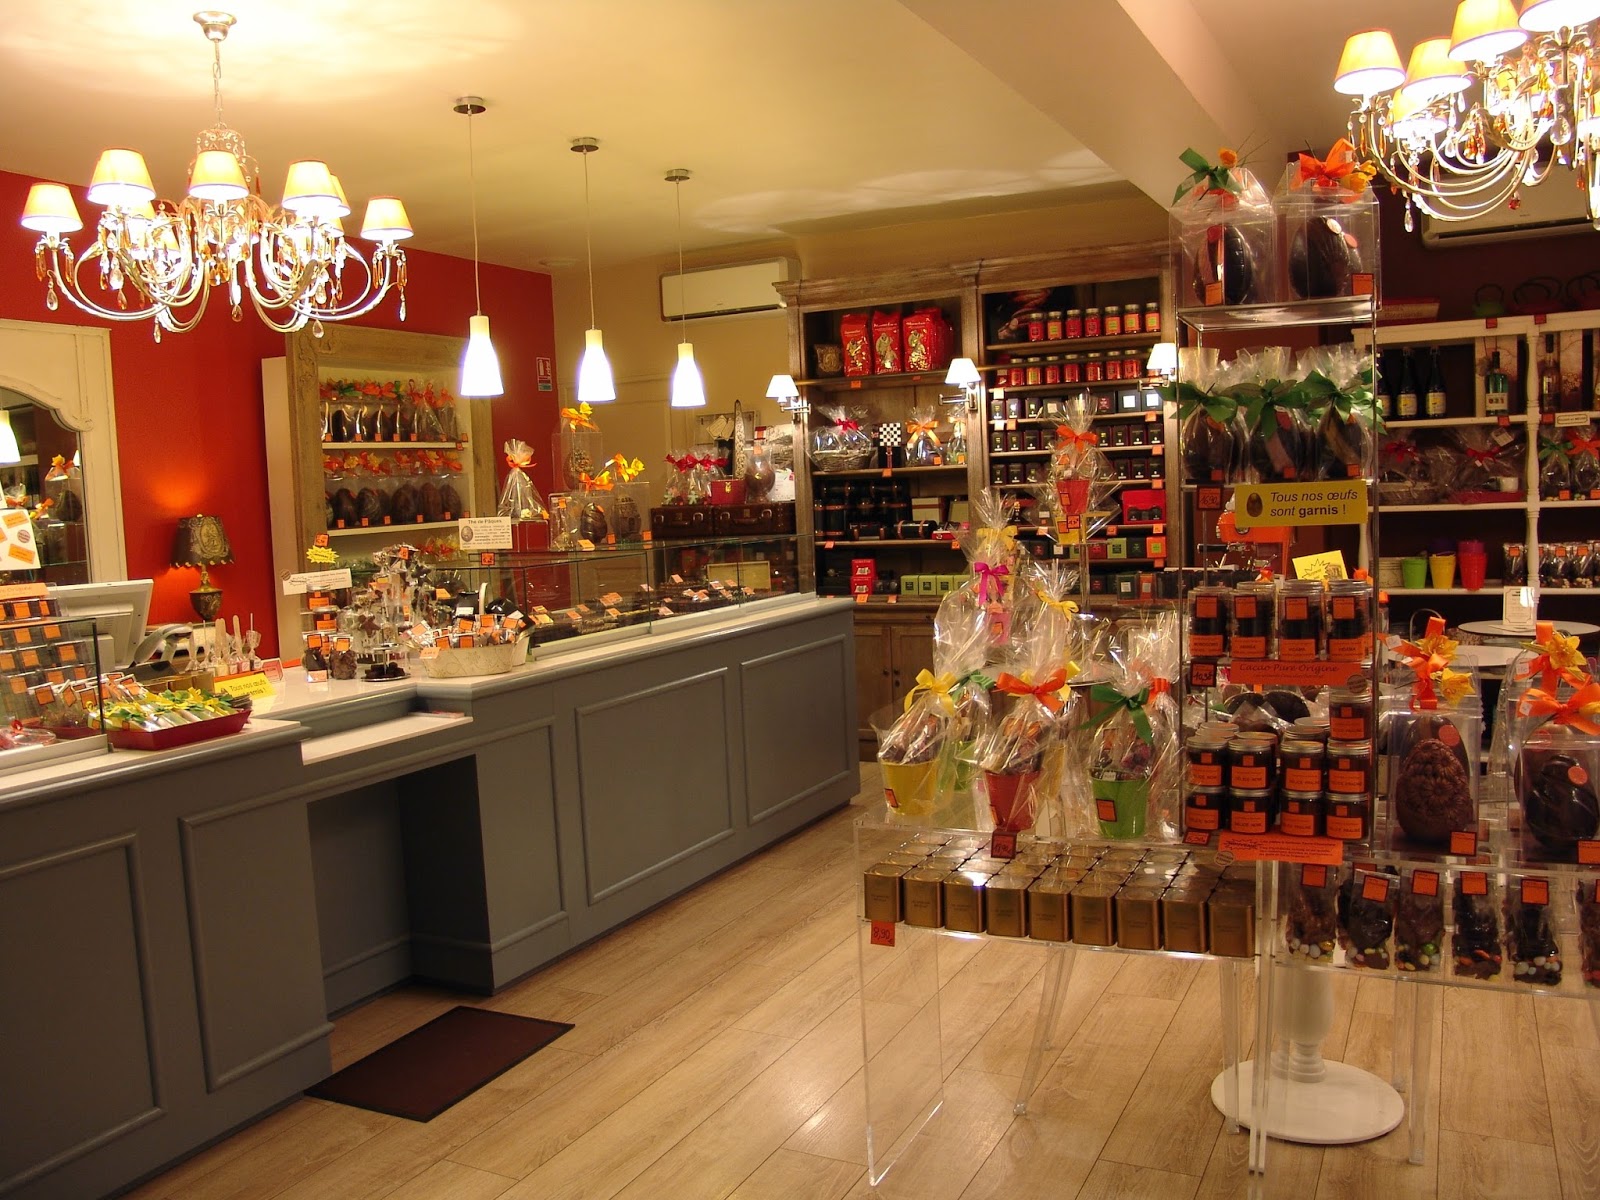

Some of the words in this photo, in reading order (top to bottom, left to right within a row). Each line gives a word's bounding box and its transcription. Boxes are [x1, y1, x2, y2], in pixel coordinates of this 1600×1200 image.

[1270, 491, 1298, 503] Tous
[1301, 492, 1323, 501] nos
[1326, 488, 1358, 501] œufs
[1270, 506, 1295, 517] sont
[1298, 504, 1338, 519] garnis
